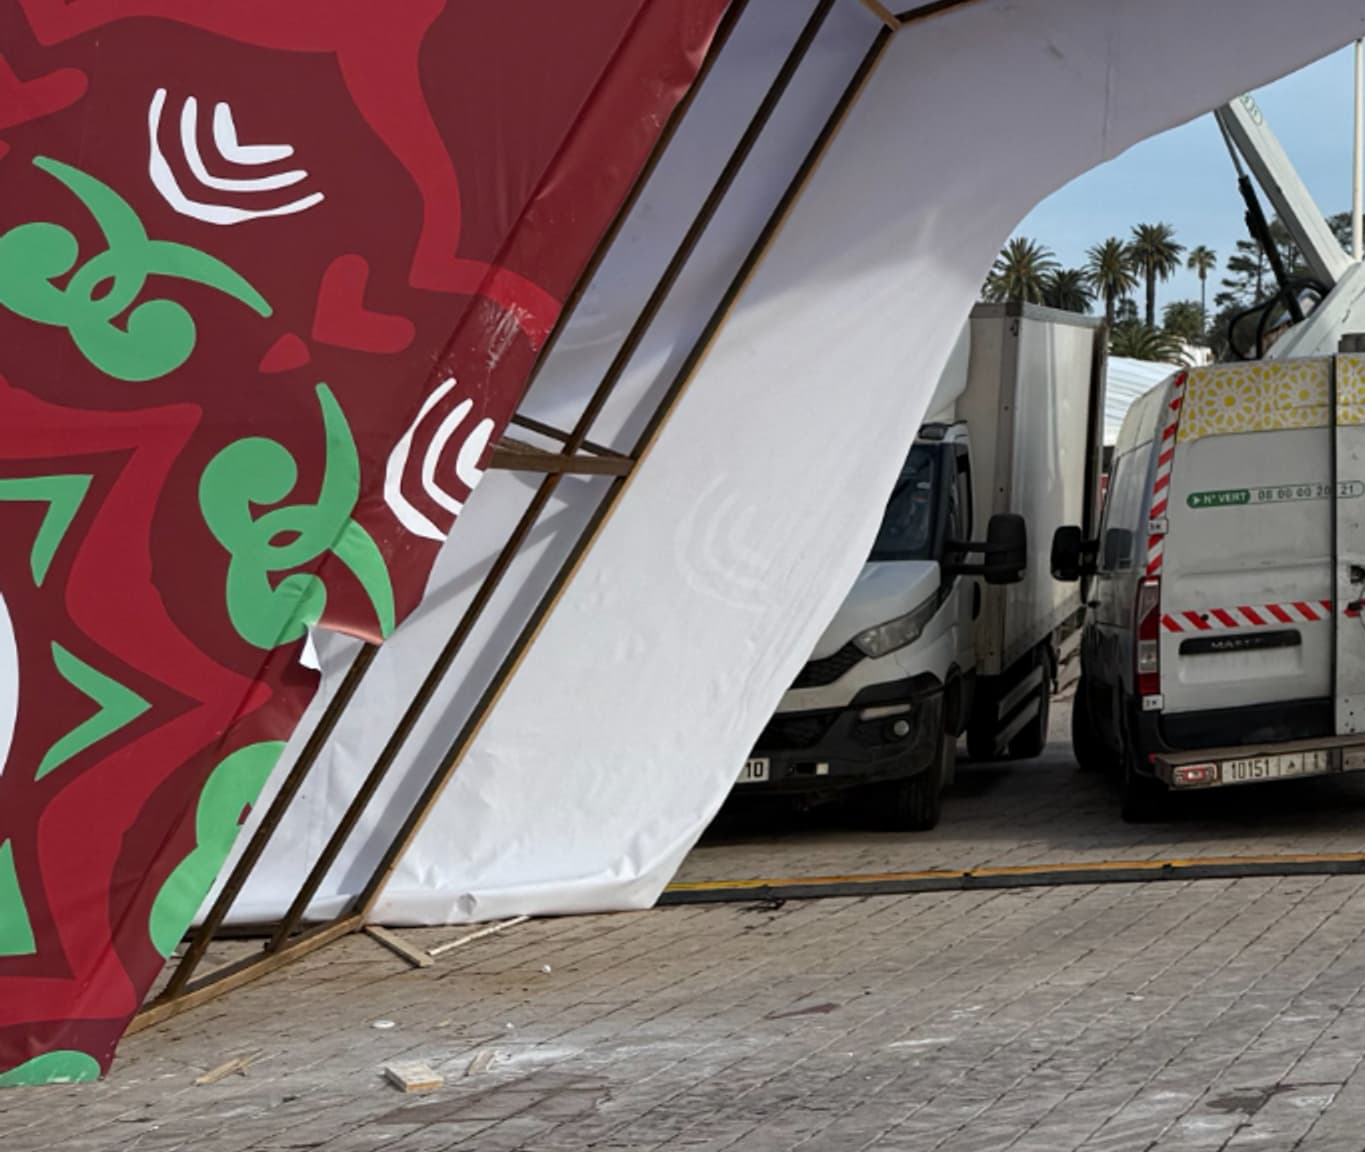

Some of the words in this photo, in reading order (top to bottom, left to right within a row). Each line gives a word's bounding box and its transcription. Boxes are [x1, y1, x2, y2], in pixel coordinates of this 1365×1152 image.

[1340, 484, 1355, 495] 21
[1219, 491, 1248, 503] VERT
[1231, 759, 1269, 779] 10151
